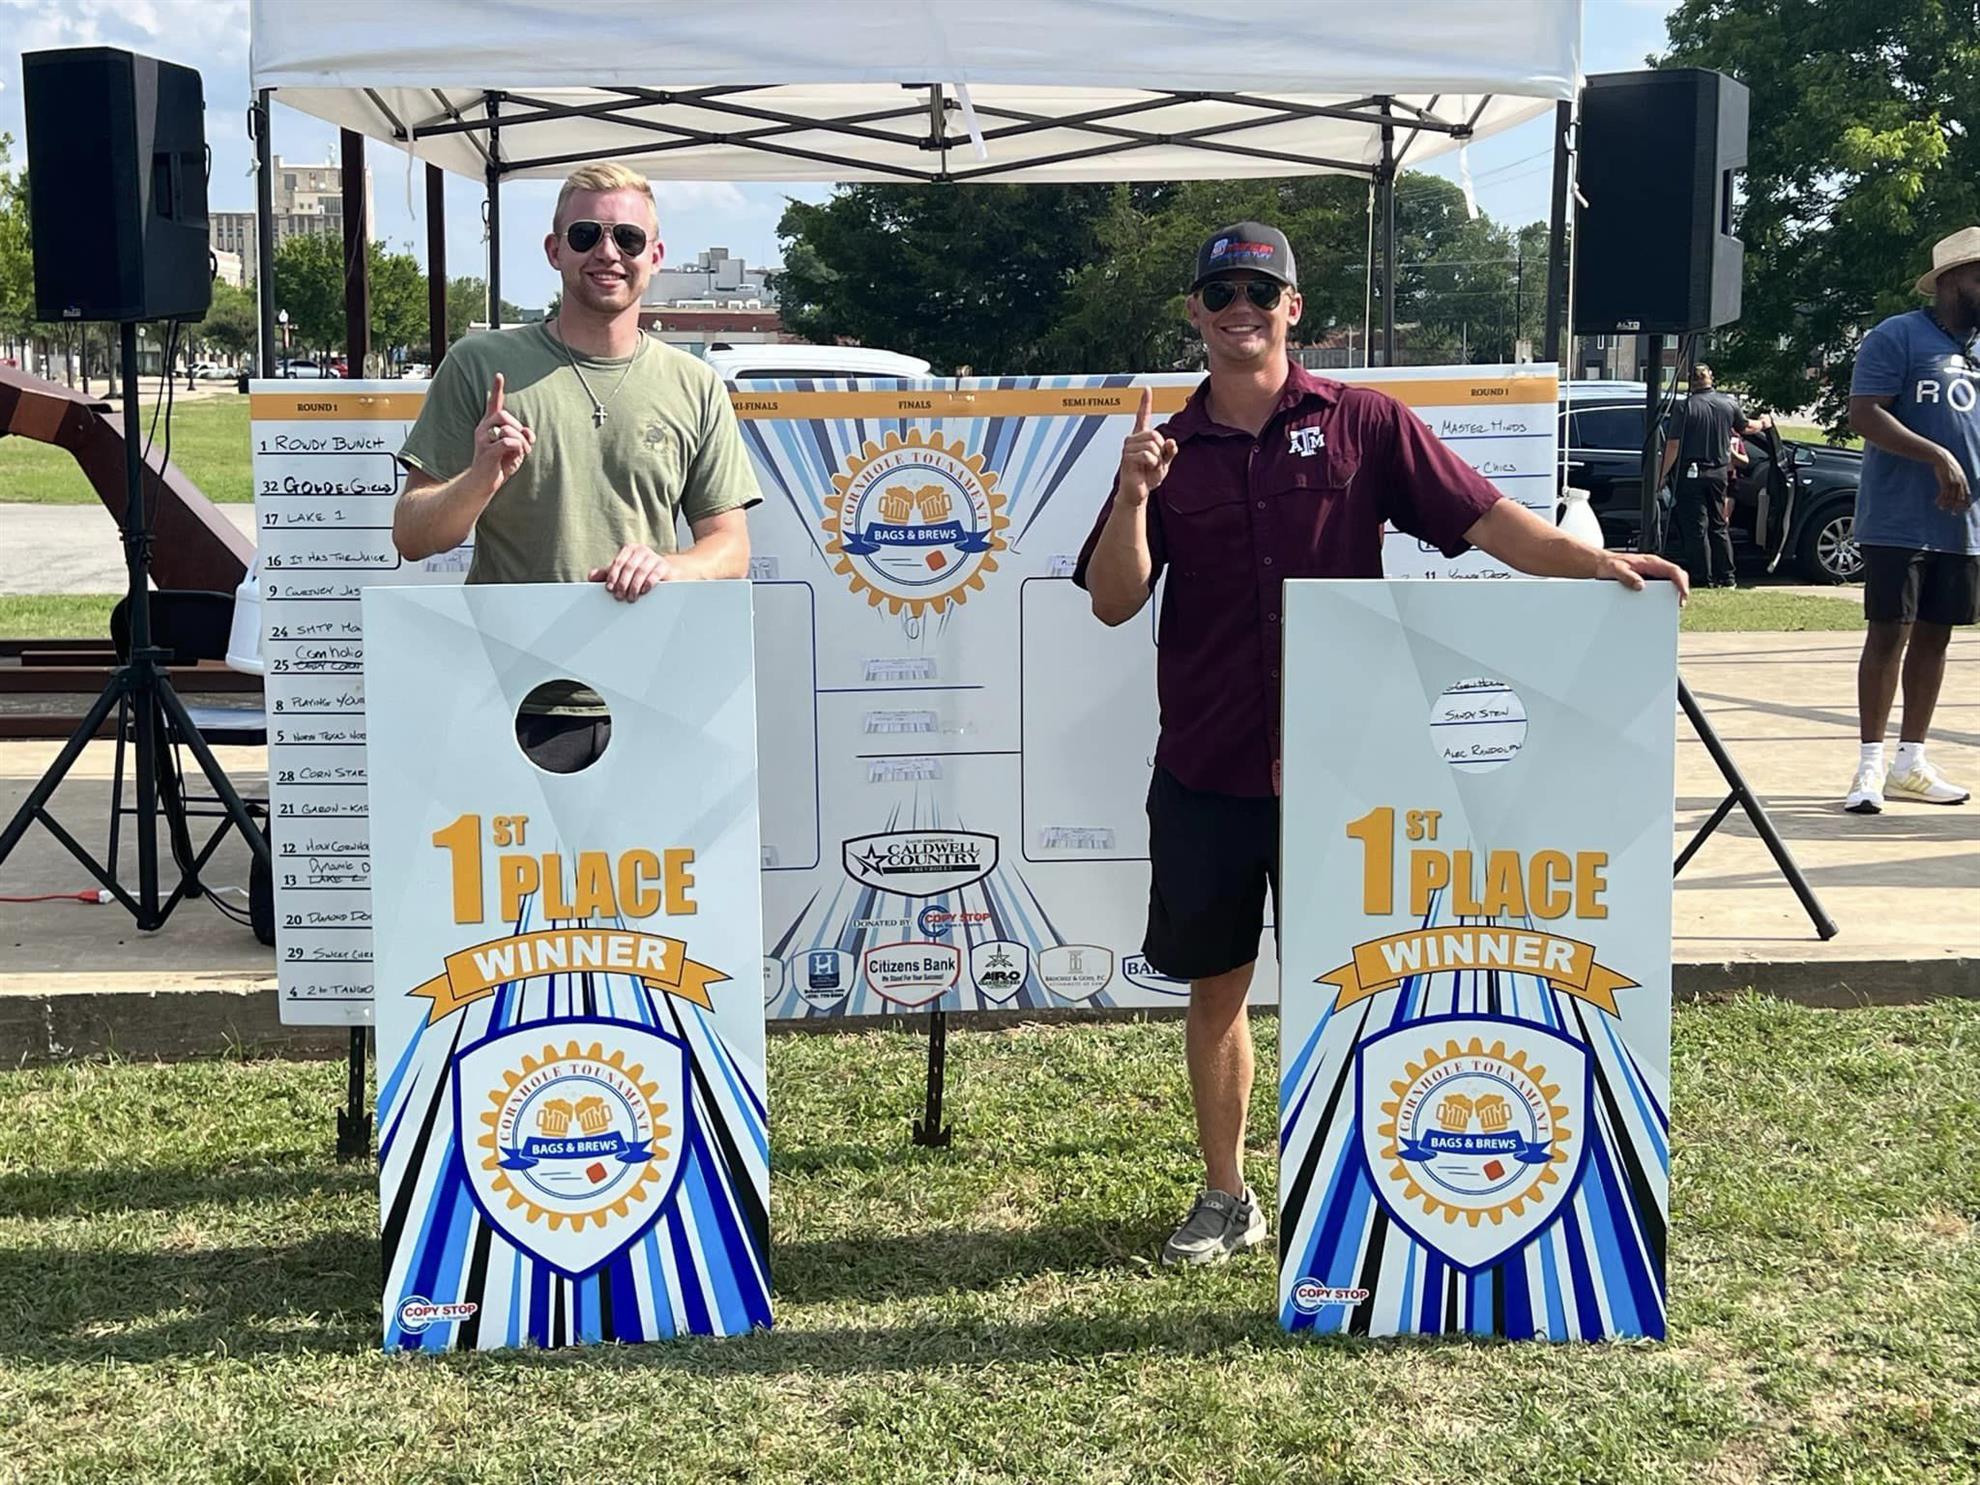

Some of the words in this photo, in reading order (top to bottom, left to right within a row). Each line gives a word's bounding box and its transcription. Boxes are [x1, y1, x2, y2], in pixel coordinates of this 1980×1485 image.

[1471, 388, 1503, 396] ROUND
[297, 403, 331, 412] ROUND
[732, 402, 778, 410] MI-FINALS
[898, 401, 932, 409] FINALS
[1062, 398, 1121, 407] SEMI-FINALS
[261, 441, 266, 451] 1
[275, 435, 327, 450] ROWDY
[332, 437, 385, 450] BUNCH
[262, 481, 278, 492] 32
[844, 453, 904, 526] CORNHOLE
[264, 514, 278, 525] 17
[287, 511, 326, 523] LAKE
[874, 530, 905, 541] BAGS
[907, 530, 916, 540] &
[918, 529, 957, 540] BREWS
[267, 556, 281, 567] 16
[269, 585, 277, 597] 9
[272, 627, 288, 638] 24
[273, 660, 289, 671] 25
[276, 700, 284, 712] 8
[277, 730, 285, 742] 5
[278, 771, 295, 782] 28
[280, 804, 294, 814] 21
[282, 843, 297, 853] 12
[887, 843, 980, 855] CALDWELL
[887, 853, 980, 866] COUNTRY
[284, 874, 297, 886] 13
[498, 848, 698, 922] PLACE
[1410, 849, 1608, 920] PLACE
[286, 914, 302, 925] 20
[854, 919, 897, 927] DONATED
[925, 913, 957, 923] COPY
[960, 912, 992, 922] STOP
[287, 947, 303, 959] 29
[472, 935, 667, 982] WINNER
[1380, 933, 1575, 975] WINNER
[869, 960, 920, 974] Citizens
[923, 957, 956, 969] Bank
[290, 986, 297, 997] 4
[1400, 1061, 1464, 1133] CORNHOLE
[499, 1066, 561, 1141] CORNHOLE
[532, 1142, 564, 1155] BAGS
[566, 1142, 575, 1152] &
[577, 1140, 618, 1152] BREWS
[1431, 1137, 1462, 1149] BAGS
[1464, 1138, 1474, 1149] &
[1476, 1138, 1517, 1149] BREWS
[1298, 1288, 1332, 1298] COPY
[1335, 1289, 1369, 1300] STOP
[405, 1306, 439, 1317] COPY
[442, 1304, 477, 1315] STOP
